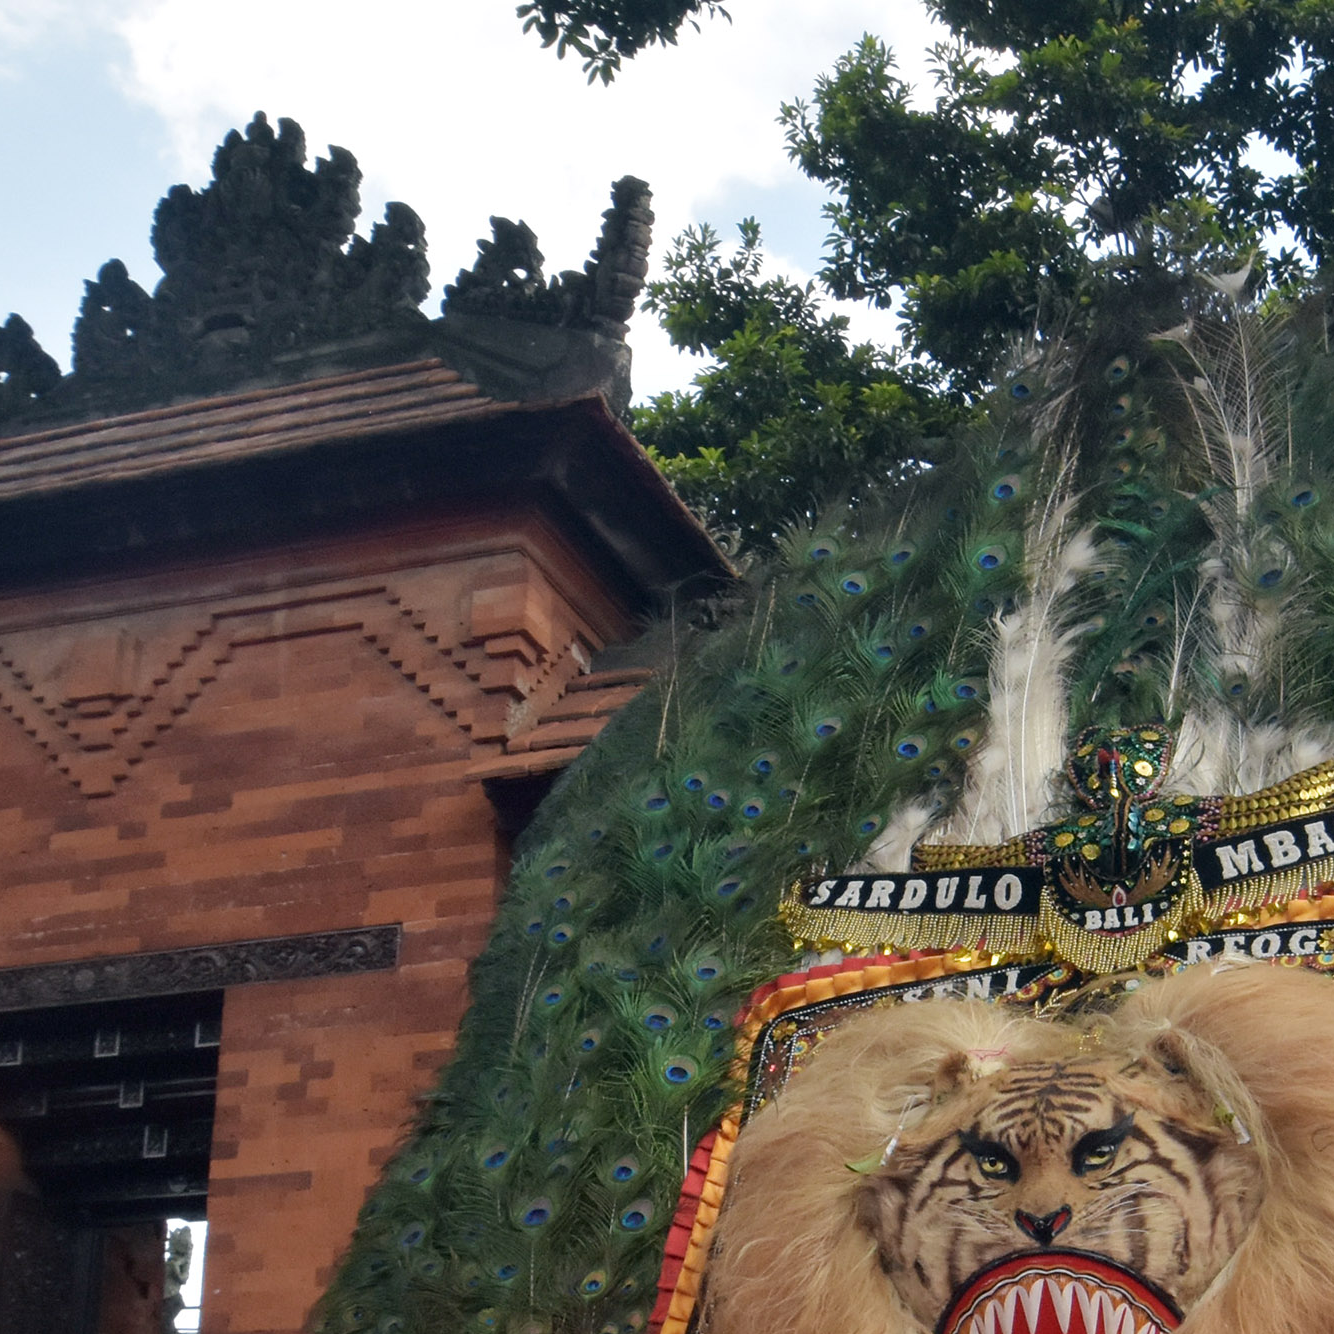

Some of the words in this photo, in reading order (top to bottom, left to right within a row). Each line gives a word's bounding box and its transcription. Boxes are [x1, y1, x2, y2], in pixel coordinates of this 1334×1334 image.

[810, 873, 1024, 912] SARDULO
[1084, 903, 1157, 932] BALI
[1186, 929, 1317, 964] REOG
